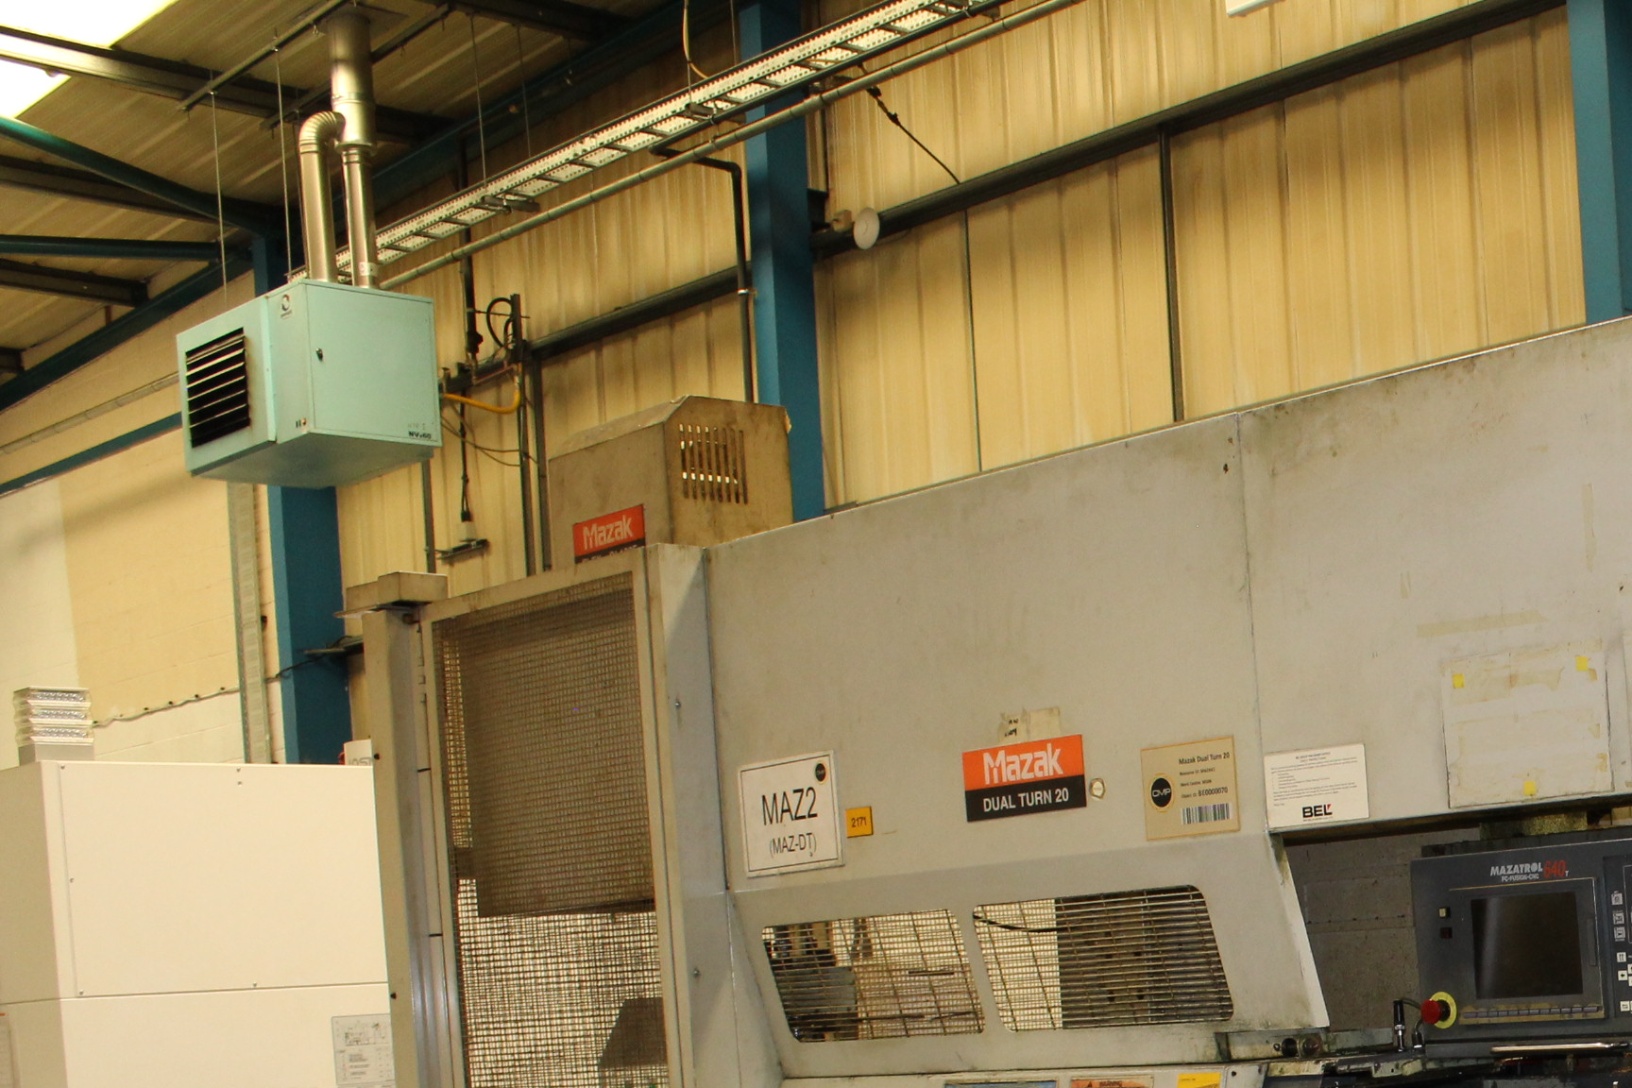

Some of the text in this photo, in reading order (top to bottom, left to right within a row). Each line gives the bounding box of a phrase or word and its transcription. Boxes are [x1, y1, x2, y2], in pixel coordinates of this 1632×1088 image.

[582, 514, 634, 550] Mazak
[982, 742, 1064, 785] Mazak
[762, 786, 818, 826] MAZ2
[983, 788, 1069, 812] DUAL TURN 20
[851, 818, 866, 828] 2171
[770, 832, 816, 858] (MAZ-DT)
[1490, 862, 1543, 876] MAZATROL
[1544, 860, 1566, 879] 640
